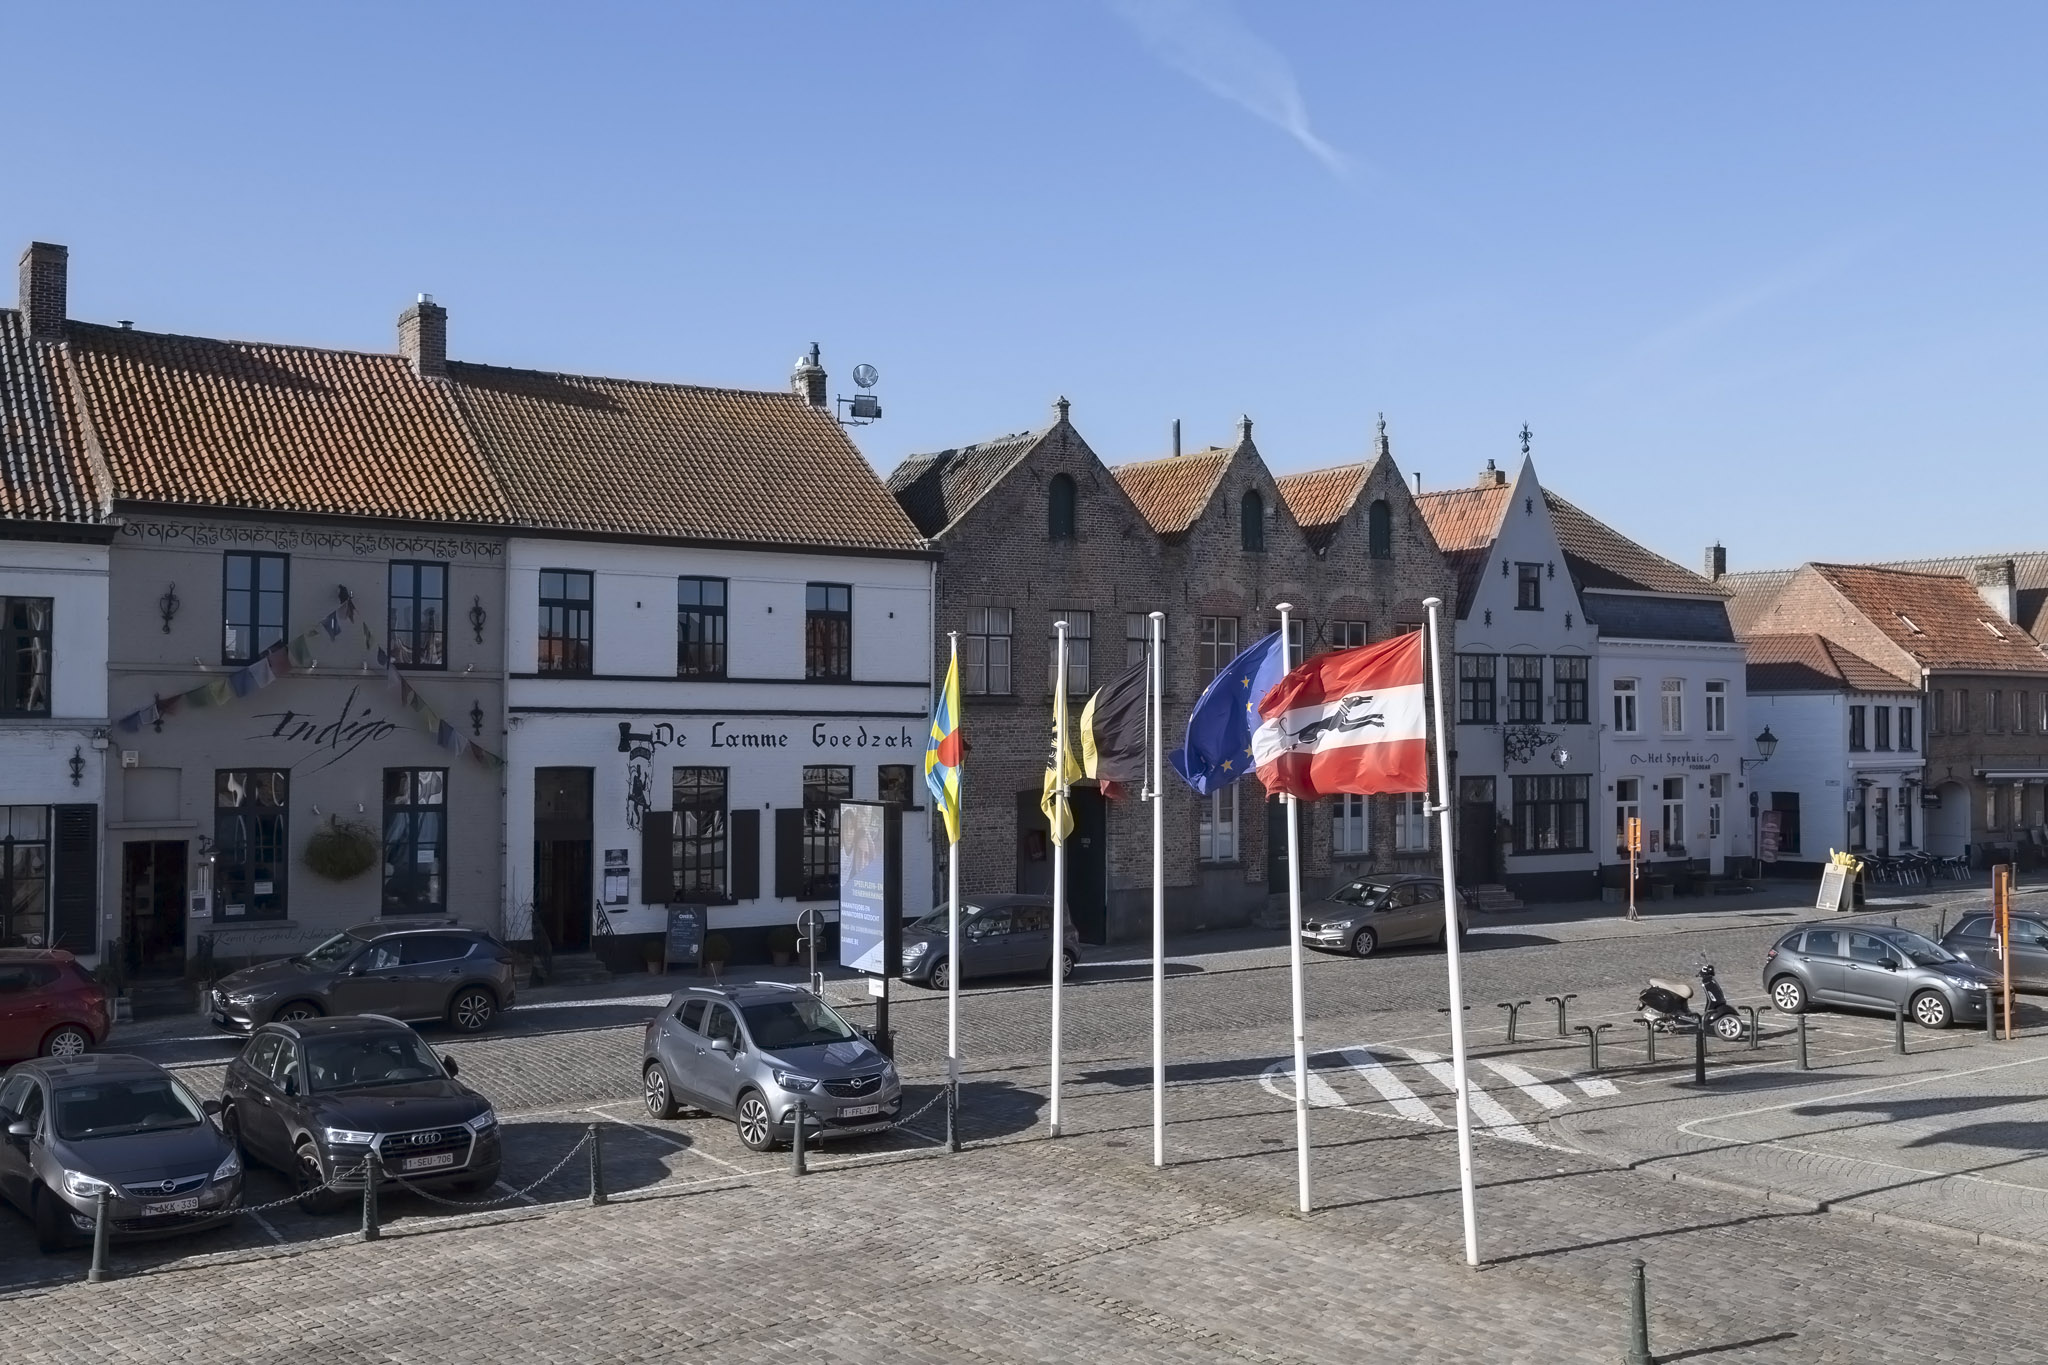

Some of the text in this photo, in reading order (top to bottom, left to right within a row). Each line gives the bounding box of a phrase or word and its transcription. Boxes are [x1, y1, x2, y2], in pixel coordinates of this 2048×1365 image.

[246, 685, 416, 776] Indigo
[653, 722, 913, 748] De Lamme Goedzak
[1648, 751, 1704, 766] Het Speyhuis
[845, 1105, 878, 1116] 1-FFL-271
[409, 1154, 452, 1168] 1-SEU-706
